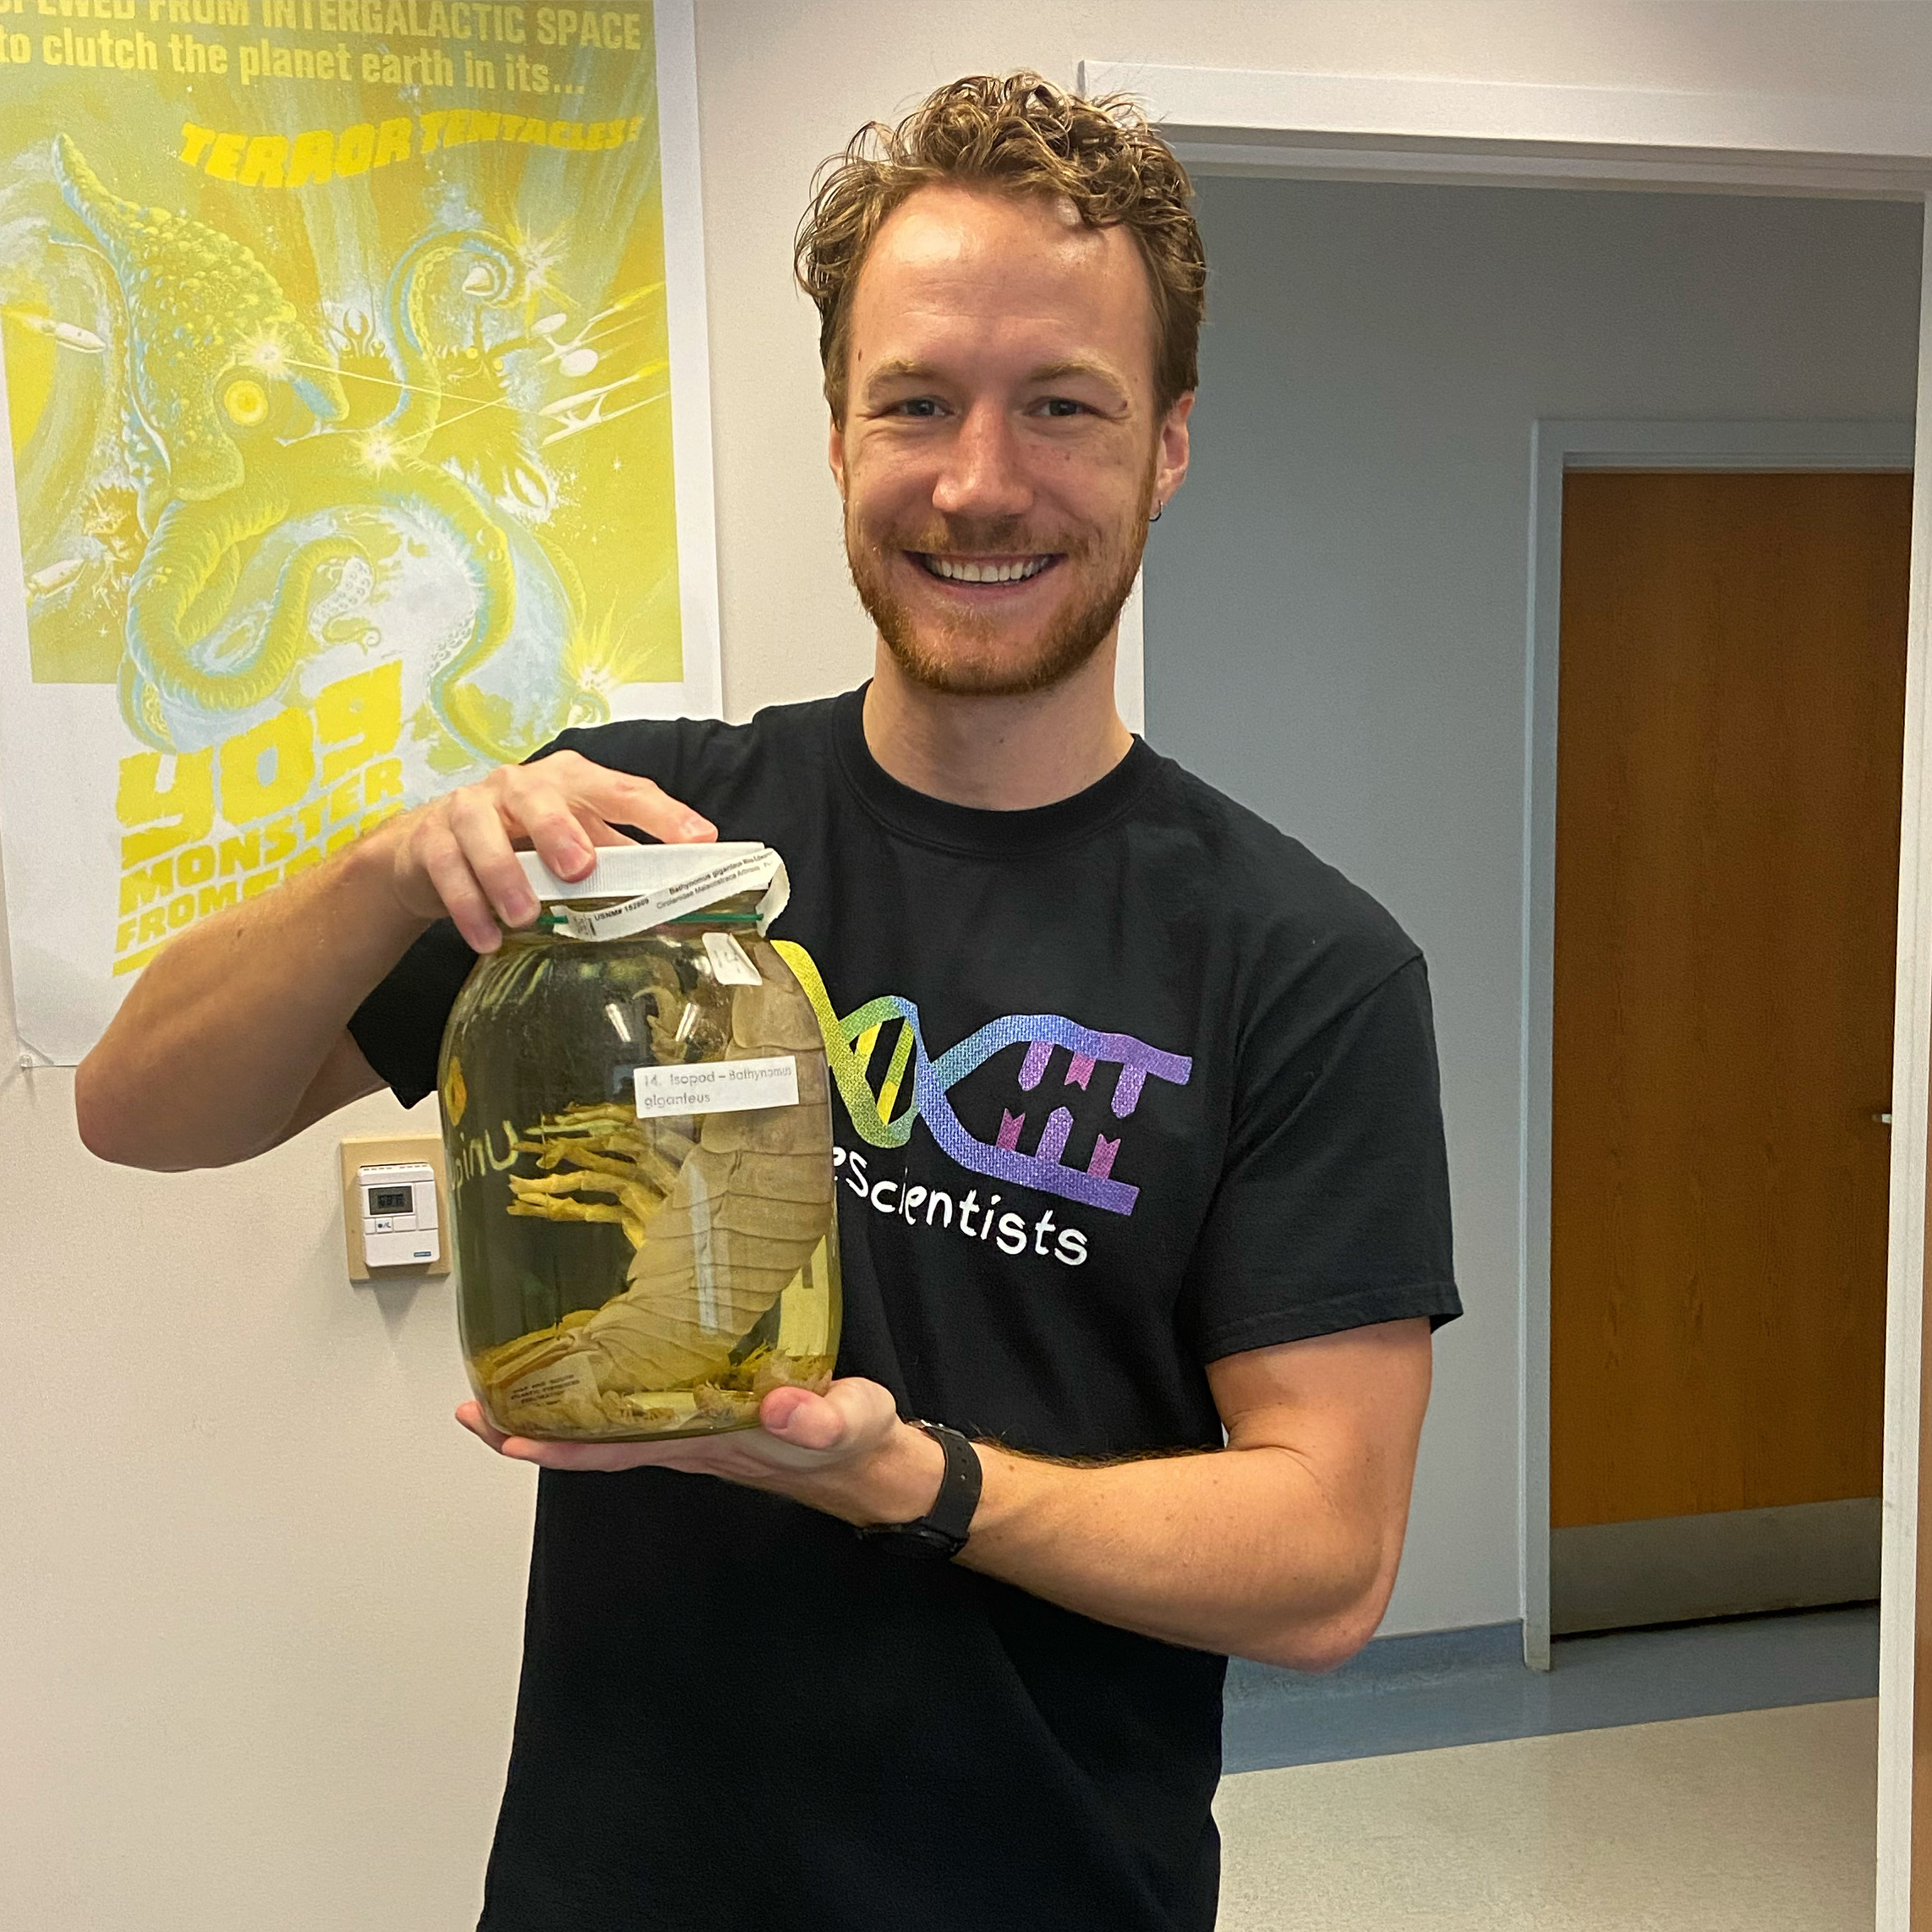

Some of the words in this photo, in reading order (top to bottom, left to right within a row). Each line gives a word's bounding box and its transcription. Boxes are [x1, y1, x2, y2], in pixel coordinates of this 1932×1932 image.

[0, 24, 31, 63] to
[42, 27, 158, 70] clutch
[168, 33, 228, 74] the
[239, 38, 352, 85] planet
[362, 47, 453, 86] earth
[464, 49, 495, 90] in
[506, 53, 585, 94] its...
[261, 0, 526, 45] INTERGALACTIC
[536, 7, 641, 51] SPACE
[178, 117, 413, 188] TERROR
[118, 758, 404, 917] MONSTER
[116, 881, 238, 953] FROM
[670, 1070, 715, 1087] Isopod
